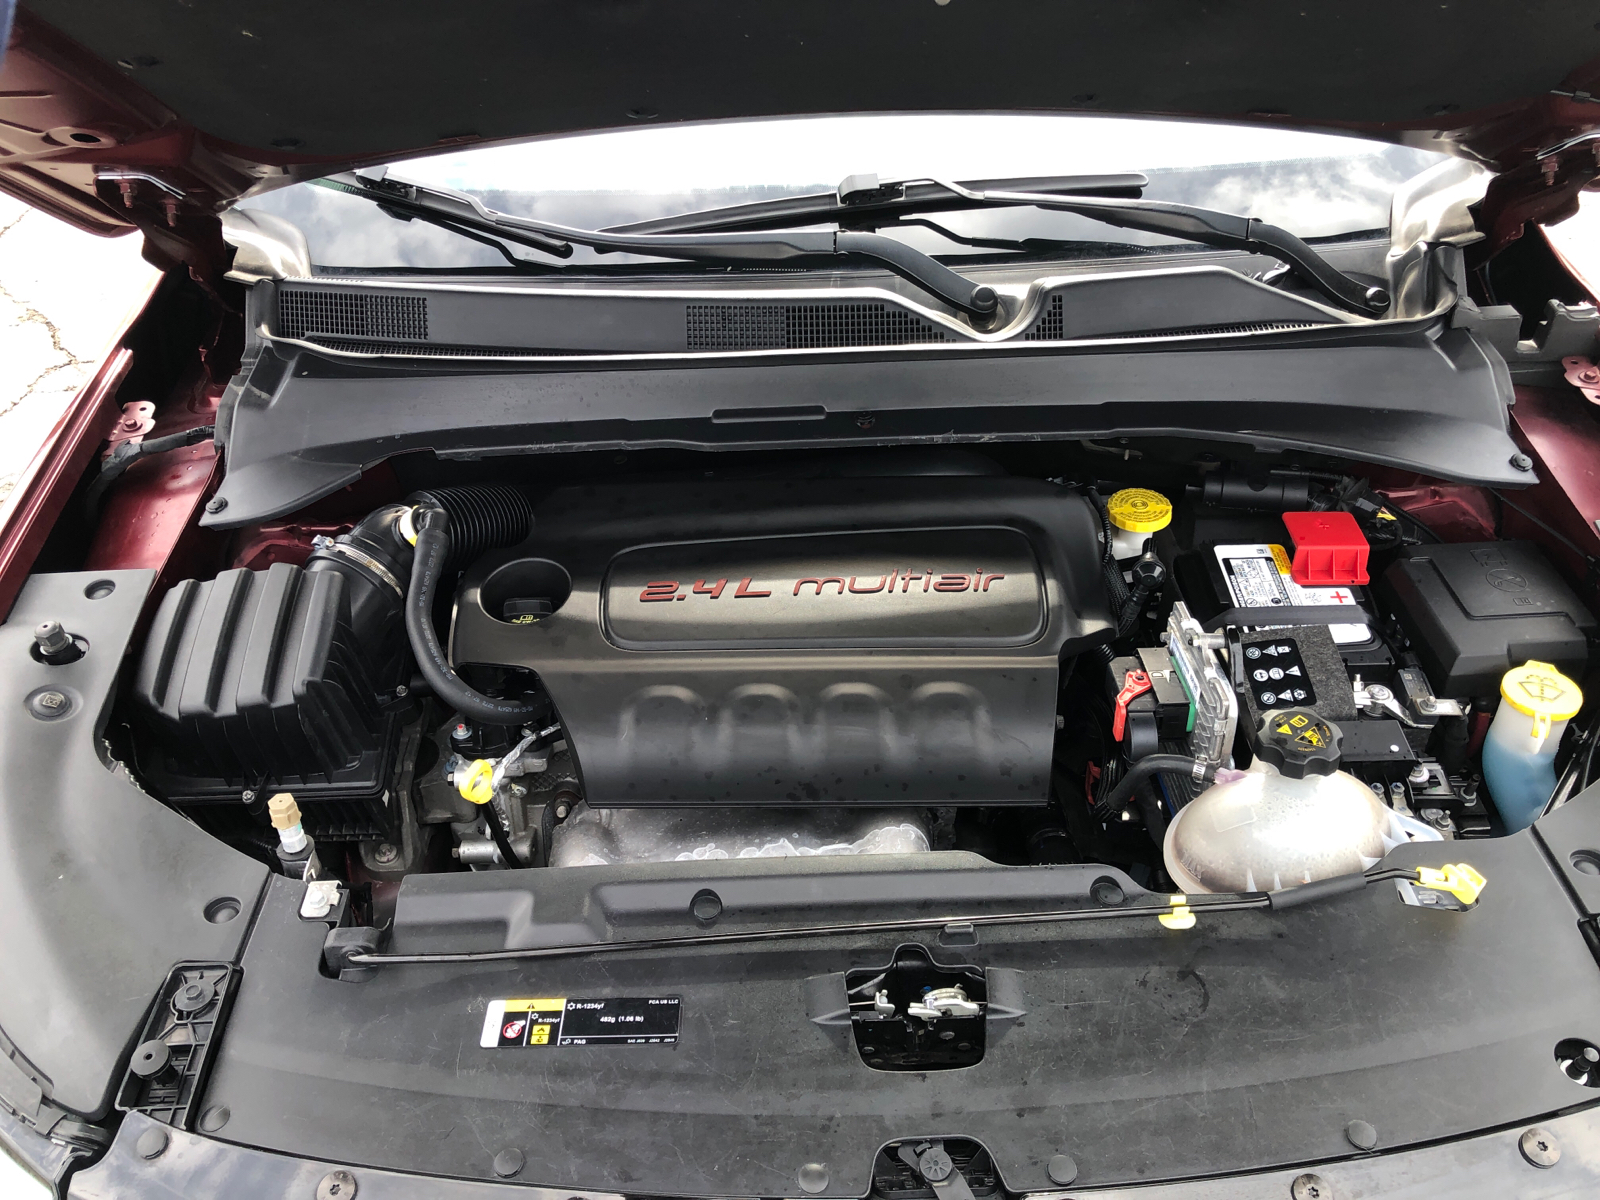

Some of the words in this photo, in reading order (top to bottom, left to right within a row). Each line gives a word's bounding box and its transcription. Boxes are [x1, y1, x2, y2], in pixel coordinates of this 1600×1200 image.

[639, 577, 772, 602] 2.4L
[793, 568, 1005, 595] multiair
[635, 1015, 644, 1023] lb)
